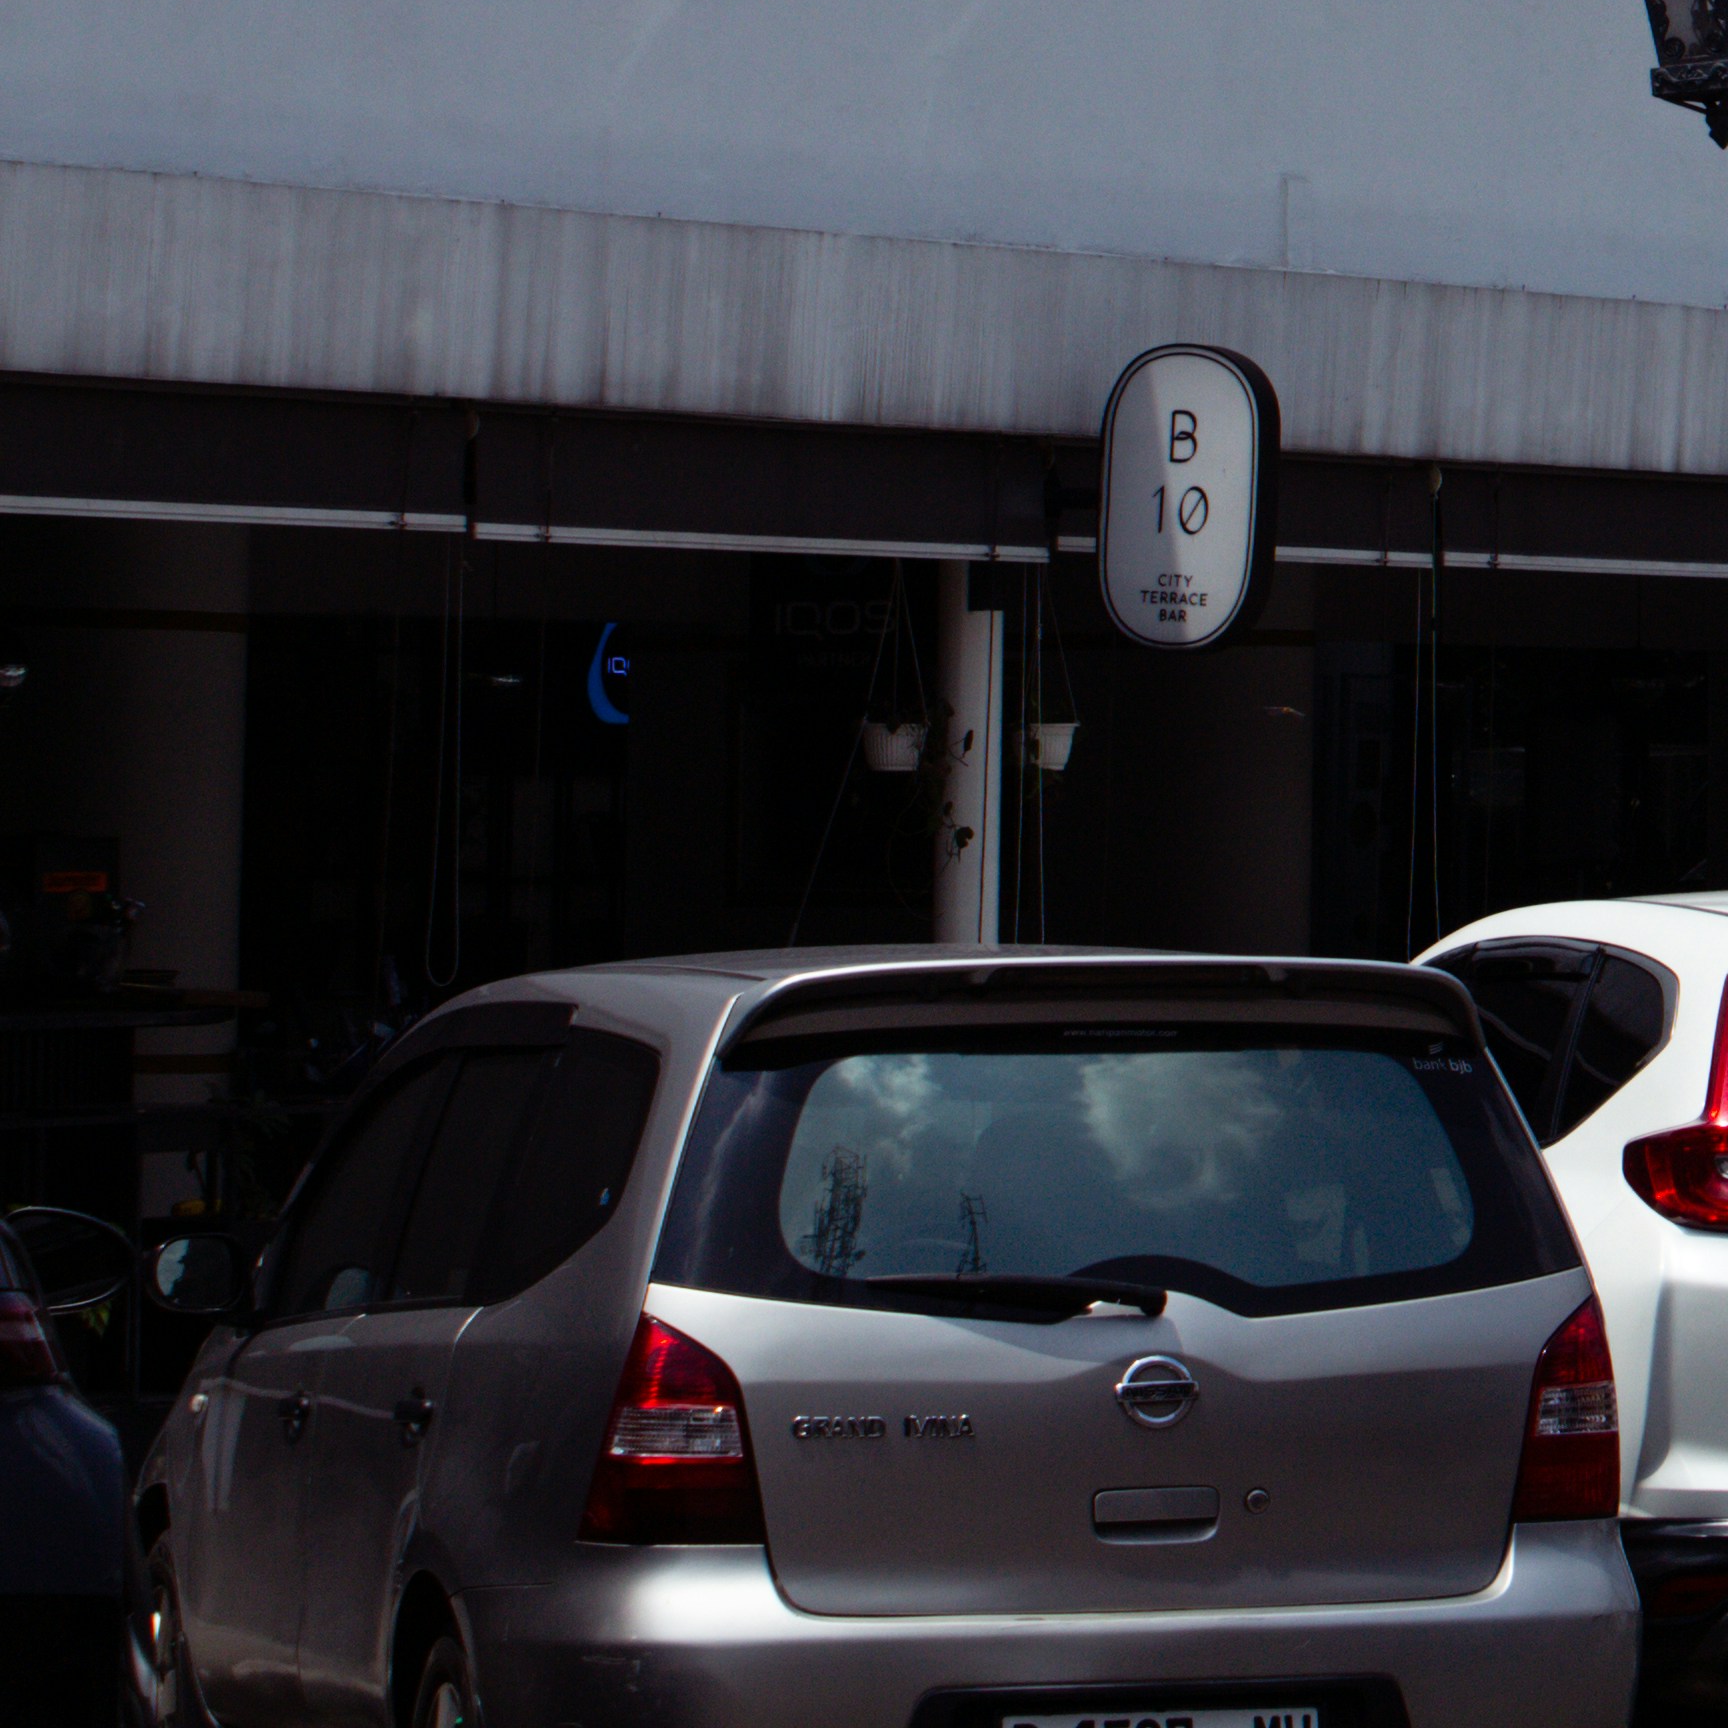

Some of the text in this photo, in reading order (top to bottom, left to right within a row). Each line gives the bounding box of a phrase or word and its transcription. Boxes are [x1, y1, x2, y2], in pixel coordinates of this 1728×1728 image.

[1170, 409, 1198, 463] B
[1152, 485, 1209, 535] 10
[1157, 573, 1194, 589] CITY
[1140, 590, 1209, 607] TERRACE
[774, 600, 896, 640] IQOS
[1158, 607, 1188, 623] BAR
[792, 1414, 888, 1440] GRAND
